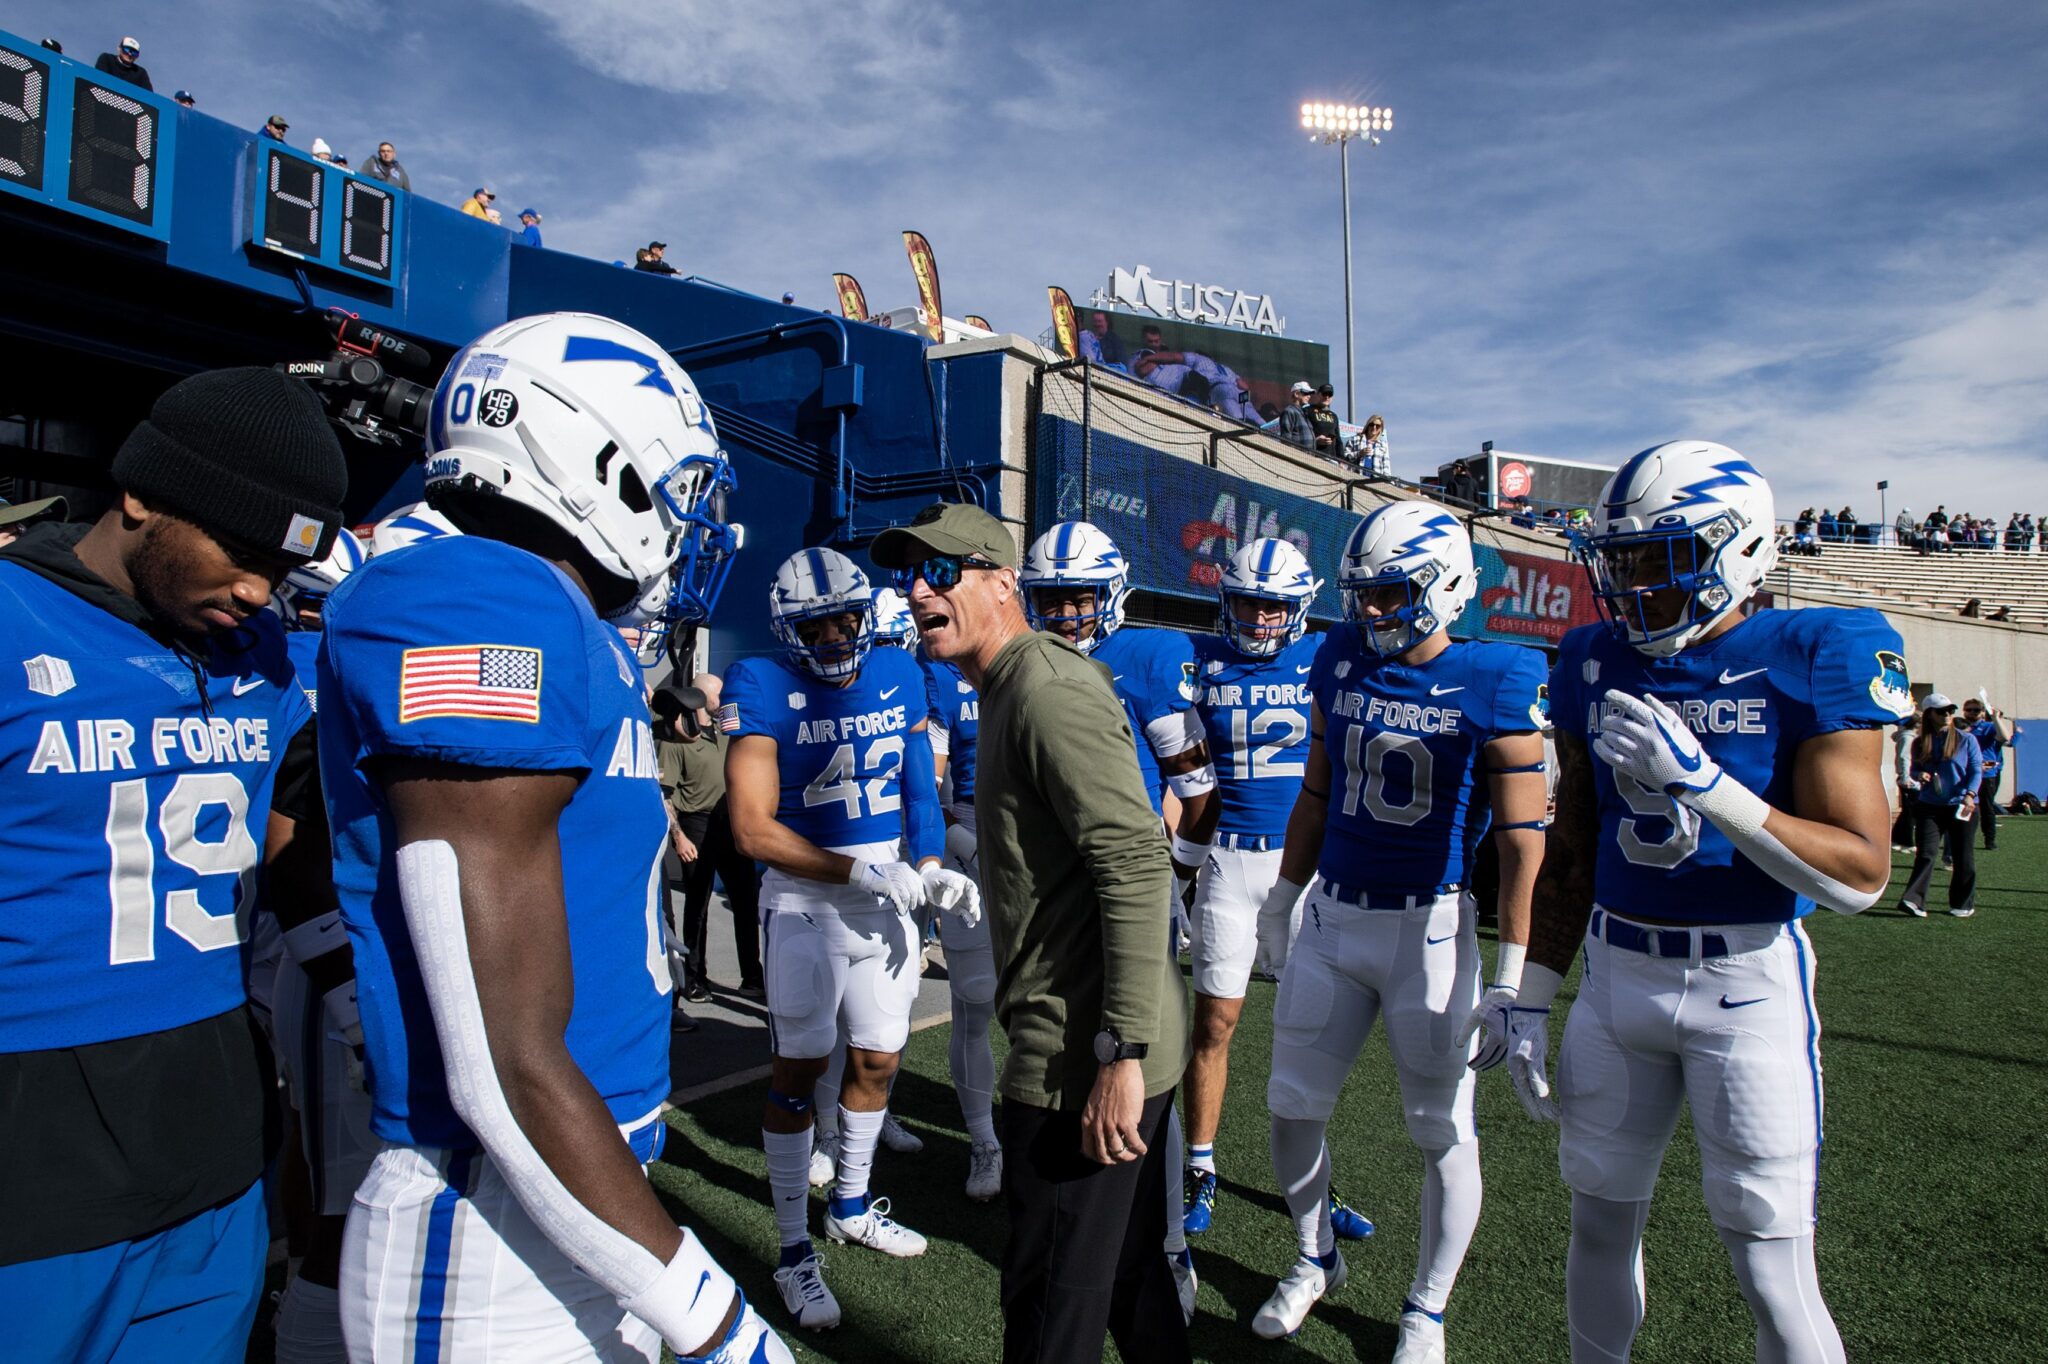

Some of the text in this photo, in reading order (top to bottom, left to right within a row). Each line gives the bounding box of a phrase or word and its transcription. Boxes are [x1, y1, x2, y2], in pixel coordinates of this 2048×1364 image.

[271, 156, 391, 271] 40
[1173, 279, 1281, 334] USAA
[288, 362, 325, 375] RONIN
[450, 382, 476, 425] 0
[484, 406, 509, 425] 79
[487, 391, 514, 409] HB
[1494, 565, 1571, 619] Alta
[1492, 617, 1562, 636] CONVENIENCE
[960, 701, 979, 722] AI
[1207, 683, 1313, 706] AIR FORC
[1332, 689, 1462, 736] AIR FORCE
[1664, 698, 1767, 734] RCE
[27, 717, 271, 773] AIR FORCE
[797, 705, 907, 744] AIR FORCE
[1231, 708, 1307, 779] 12
[803, 735, 906, 820] 42
[1342, 723, 1434, 826] 10
[105, 772, 258, 965] 19
